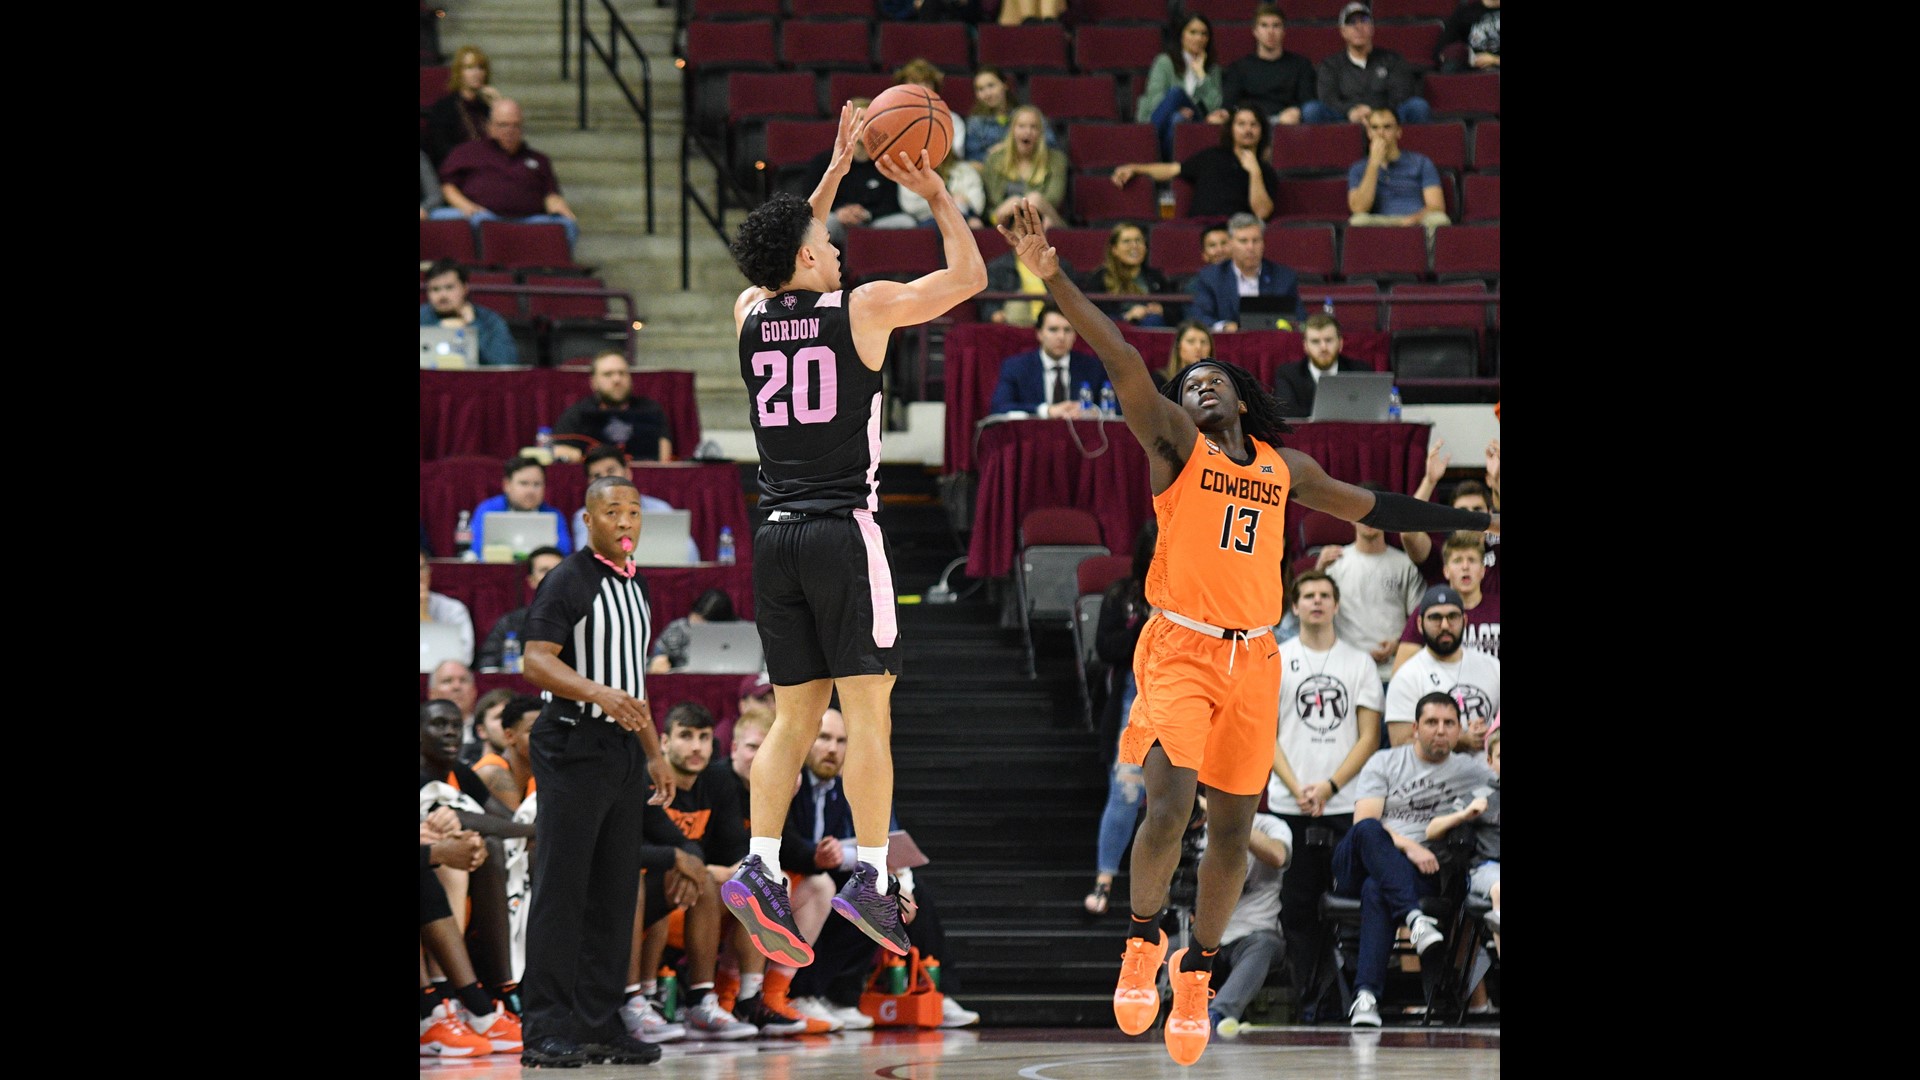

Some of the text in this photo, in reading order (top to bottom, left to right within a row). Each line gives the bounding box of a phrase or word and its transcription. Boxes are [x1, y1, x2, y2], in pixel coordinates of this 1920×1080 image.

[761, 317, 820, 342] GORDON
[751, 346, 837, 427] 20
[1200, 468, 1282, 507] COWBOYS
[1218, 503, 1262, 556] 13
[879, 1000, 897, 1023] G
